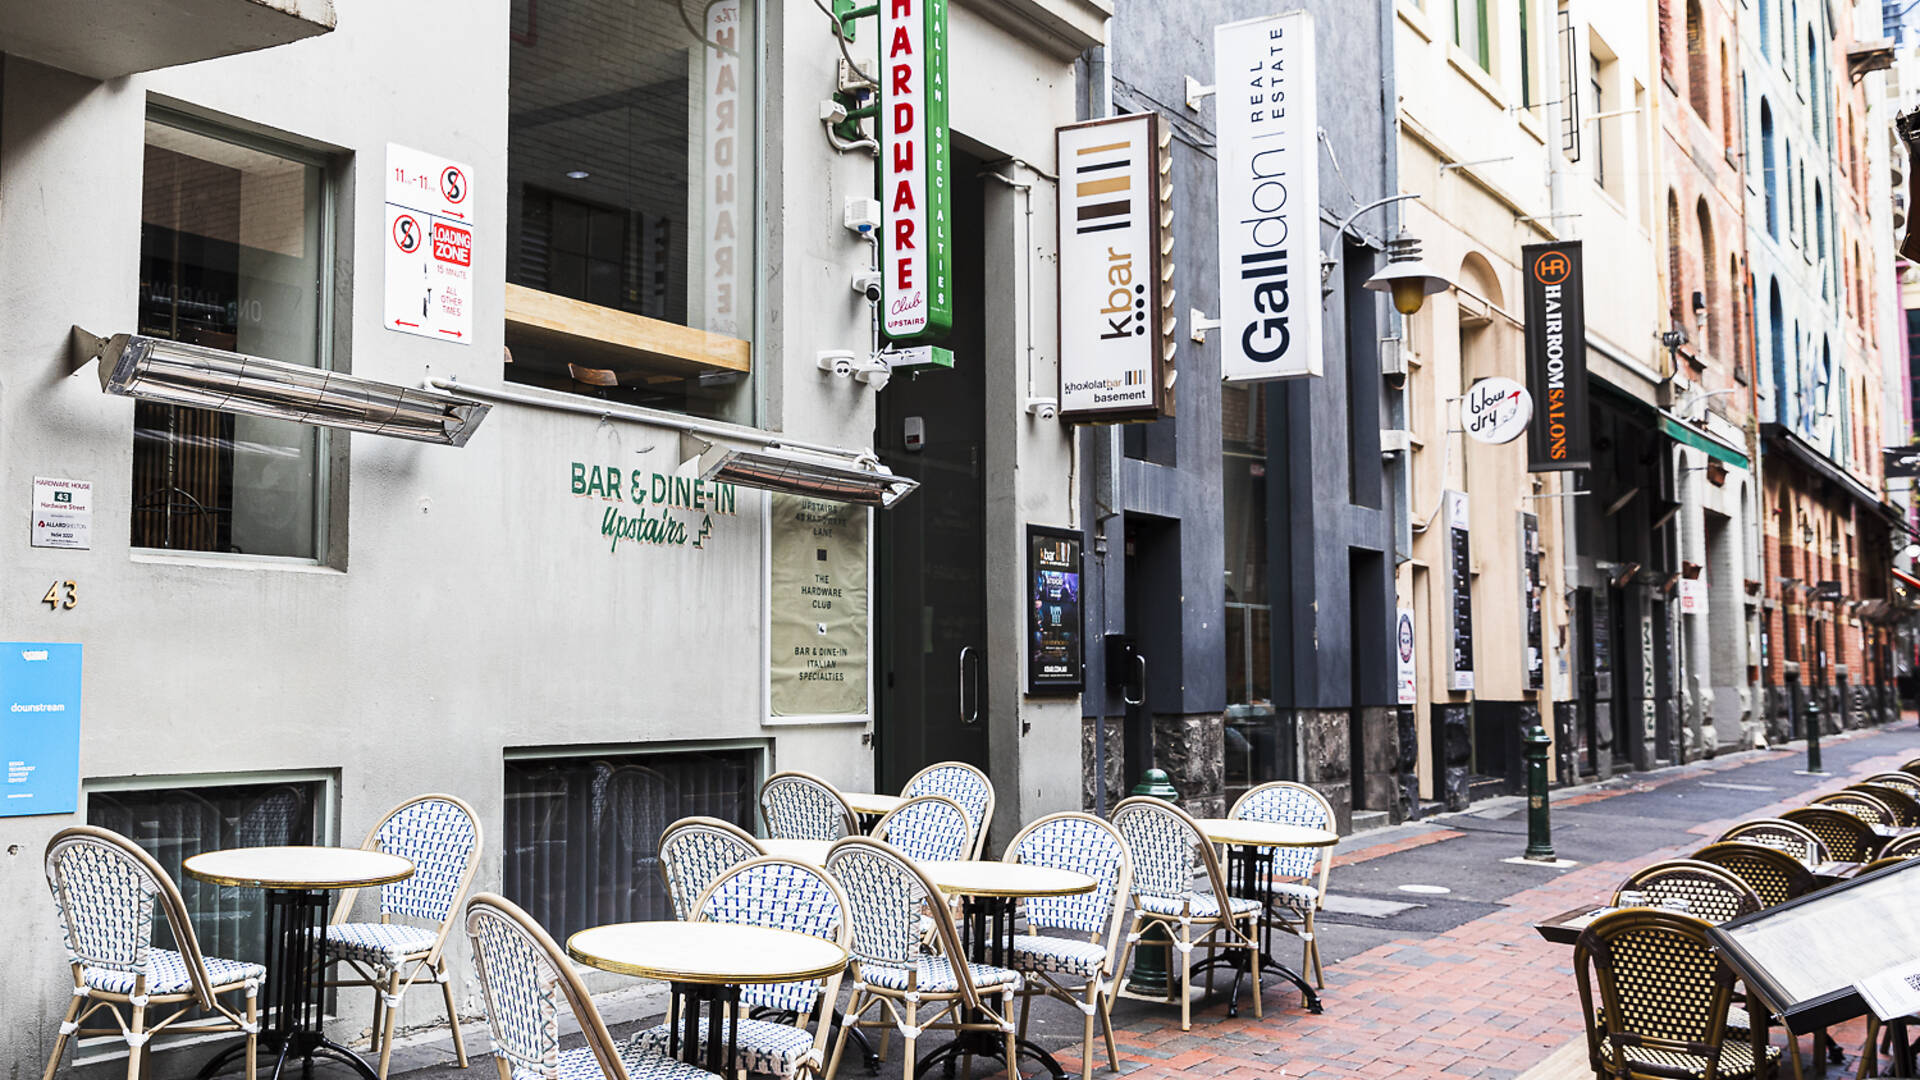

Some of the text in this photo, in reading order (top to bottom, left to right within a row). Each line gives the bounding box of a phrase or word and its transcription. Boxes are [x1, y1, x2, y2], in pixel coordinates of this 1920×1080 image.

[933, 2, 942, 102] TALIAN
[1270, 27, 1285, 120] ESTATE
[1250, 60, 1264, 123] REAL
[890, 0, 916, 290] HARDWARE
[935, 126, 945, 305] SPECIALTIES
[434, 225, 471, 248] LOADING
[436, 243, 469, 263] ZONE
[1240, 148, 1290, 364] Galldon
[445, 267, 467, 280] MINUTE
[891, 291, 922, 316] Club
[887, 317, 925, 328] UPSTAIRS
[1094, 390, 1146, 403] basement
[1471, 387, 1505, 415] blow
[1470, 409, 1498, 432] dry
[71, 482, 90, 490] HOUSE
[571, 462, 737, 515] BAR & DINE-IN
[56, 492, 69, 502] 43
[601, 506, 689, 553] Upstairs
[815, 574, 830, 584] THE
[41, 580, 78, 611] 43
[801, 586, 842, 598] HARDWARE
[812, 600, 832, 610] CLUB
[794, 647, 848, 657] BAR & DINE-IN
[807, 659, 837, 669] ITALIAN
[799, 672, 844, 682] SPECIALTIES
[10, 702, 65, 713] downstream
